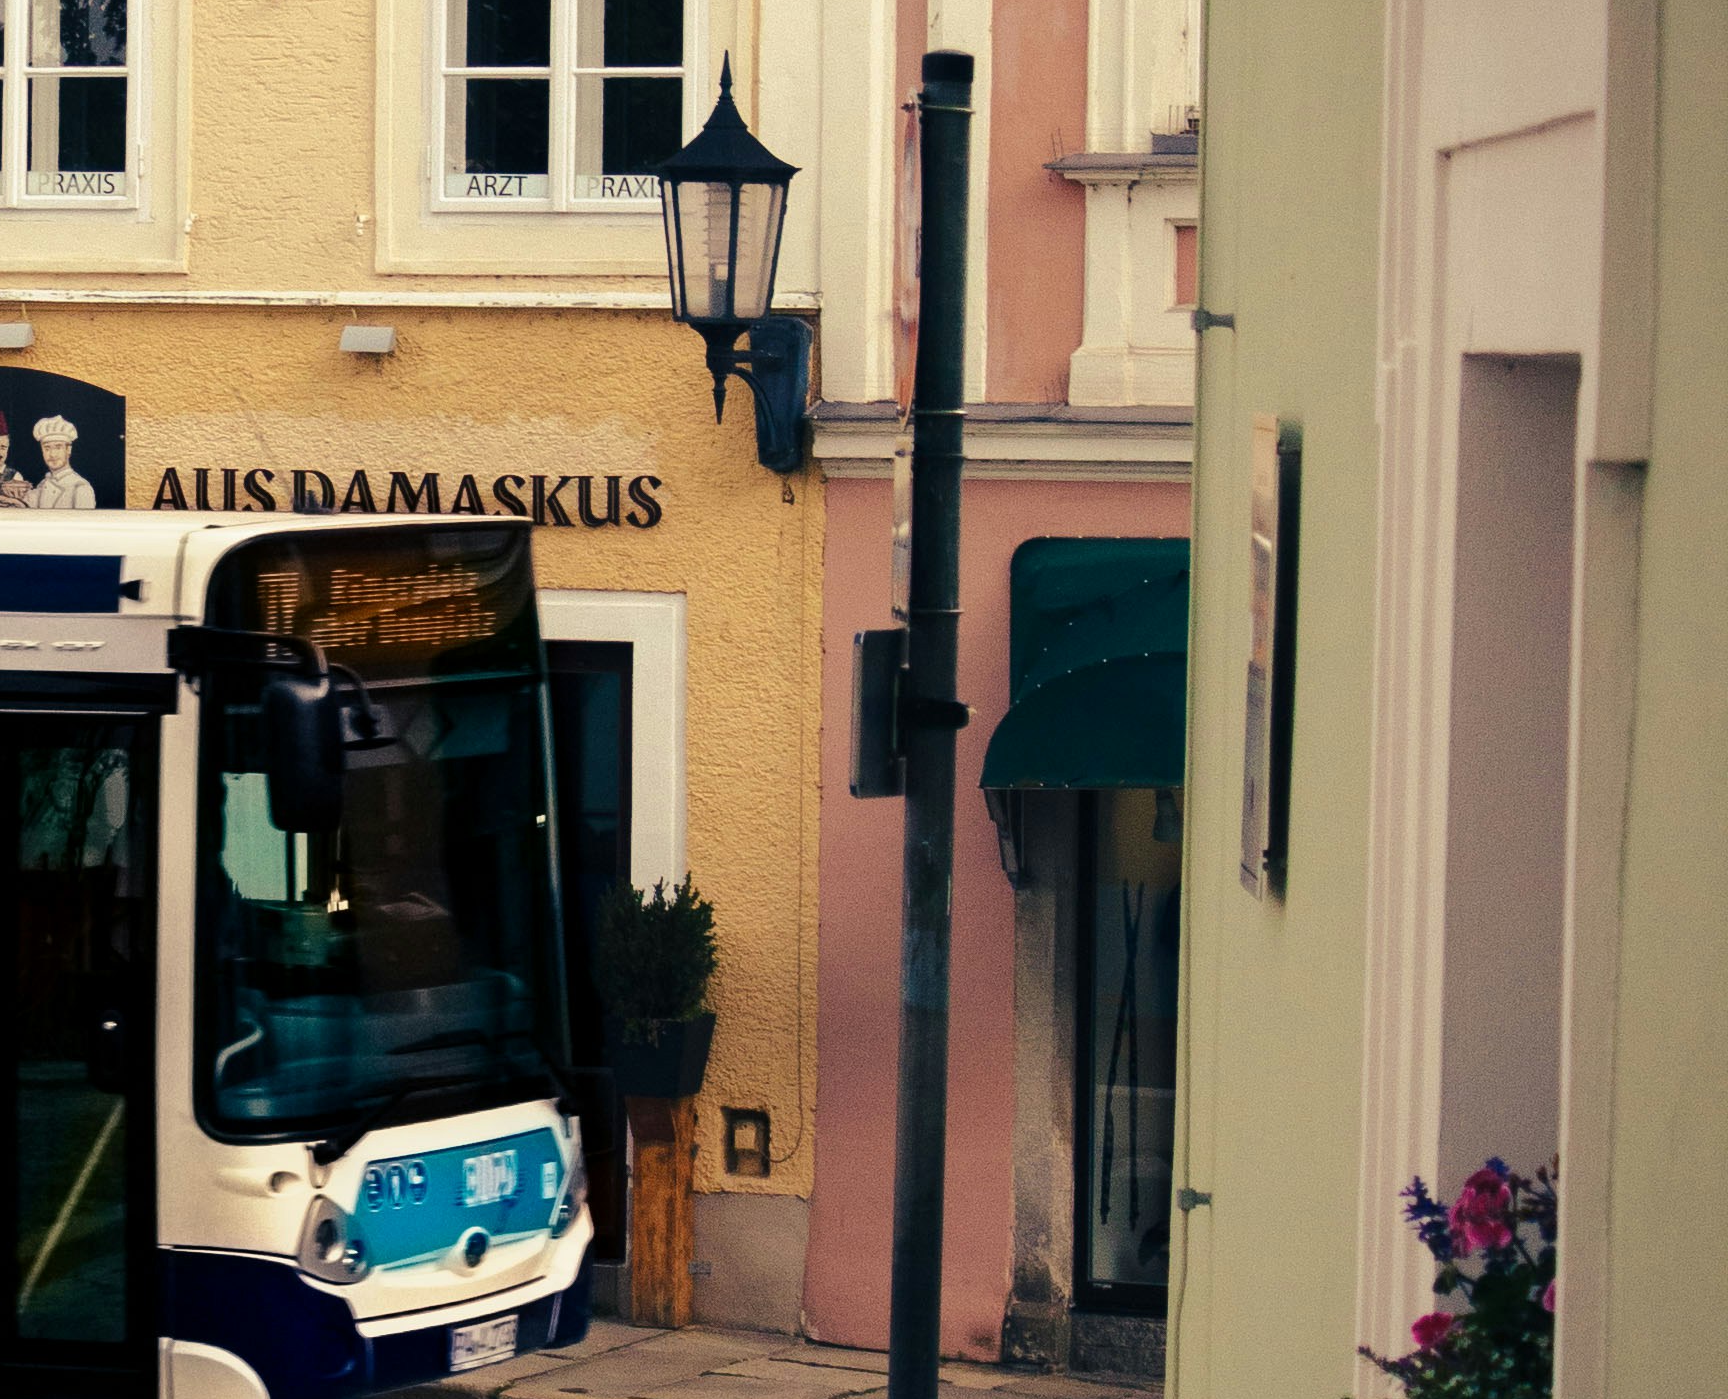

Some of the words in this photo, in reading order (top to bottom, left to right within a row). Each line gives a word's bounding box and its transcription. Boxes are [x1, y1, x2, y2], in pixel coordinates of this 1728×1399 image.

[39, 173, 116, 195] PRAXIS
[467, 174, 528, 197] ARZT
[152, 466, 277, 512] AUS
[291, 468, 663, 529] DAMASKUS
